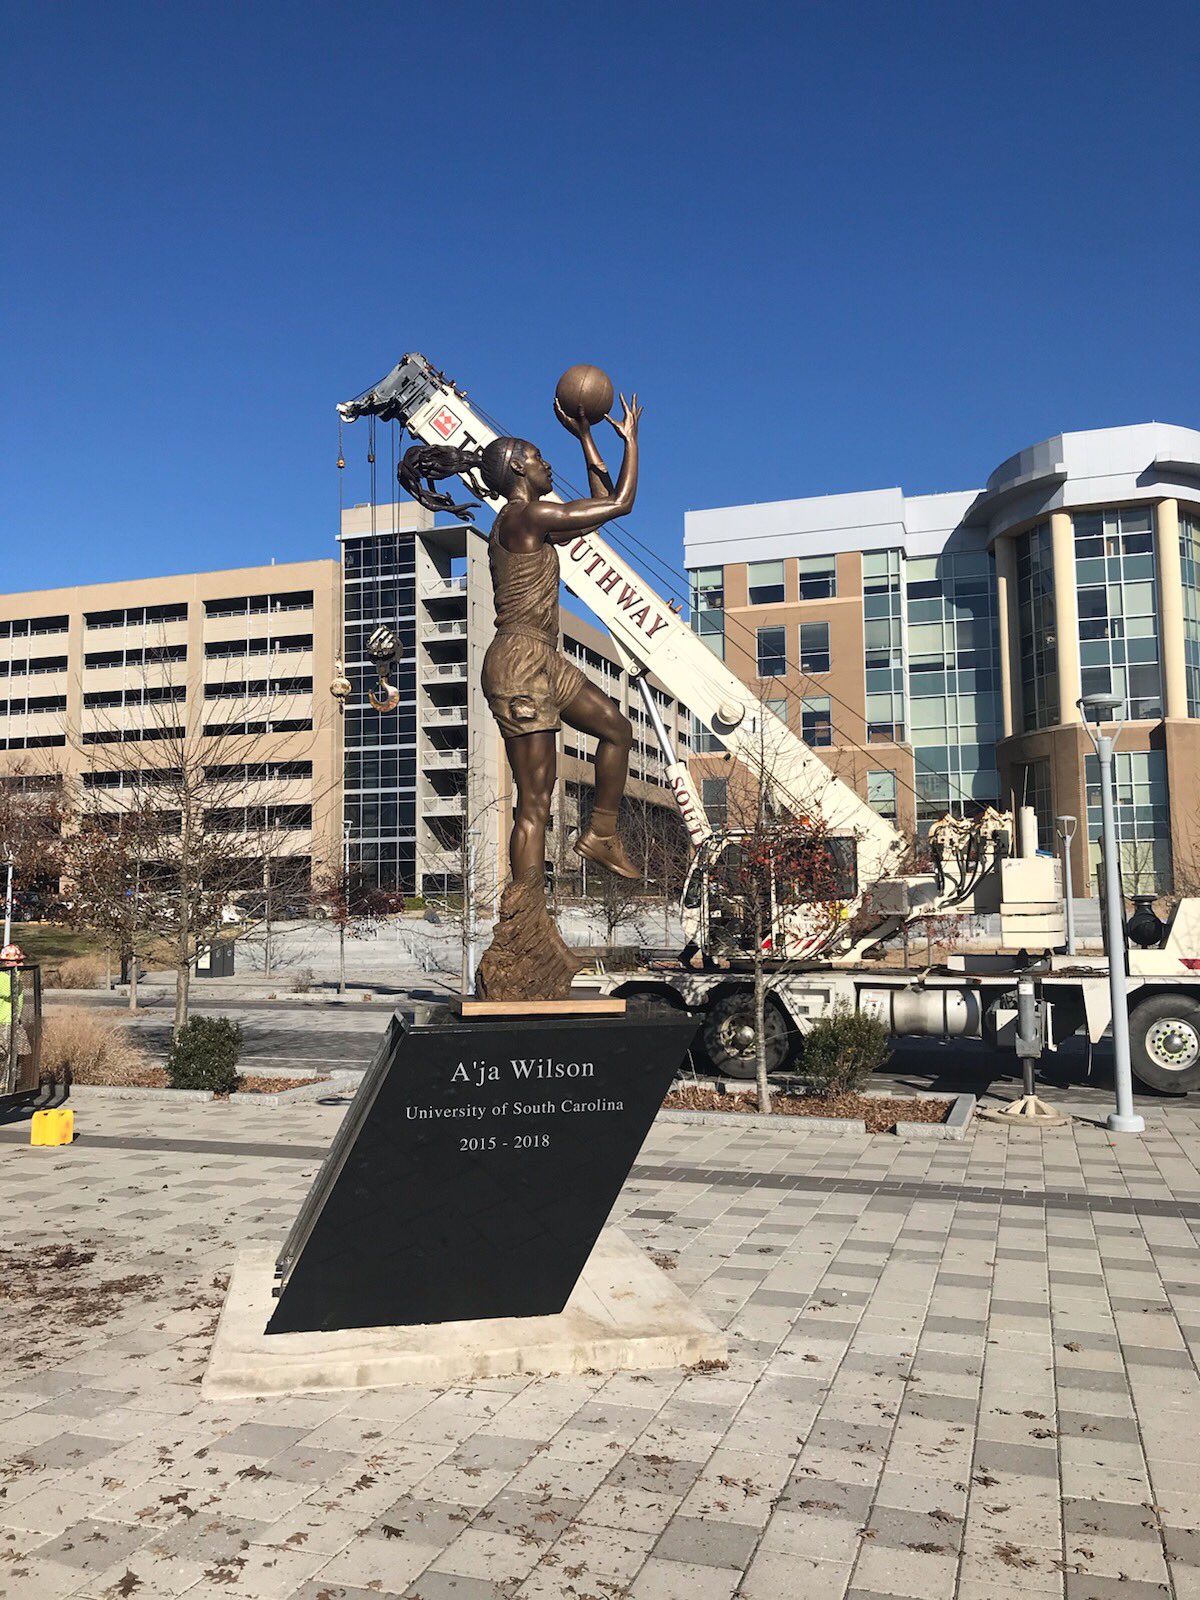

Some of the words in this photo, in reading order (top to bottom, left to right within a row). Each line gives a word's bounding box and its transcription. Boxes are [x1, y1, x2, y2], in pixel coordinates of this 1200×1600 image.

[559, 535, 669, 639] UTHWAY
[670, 776, 704, 848] SOUT
[450, 1061, 501, 1087] A'ja
[510, 1058, 595, 1080] Wilson
[406, 1103, 487, 1120] University
[491, 1102, 509, 1116] of
[513, 1100, 556, 1115] South
[561, 1098, 624, 1113] Carolina
[459, 1136, 497, 1152] 2015
[513, 1134, 550, 1149] 2018
